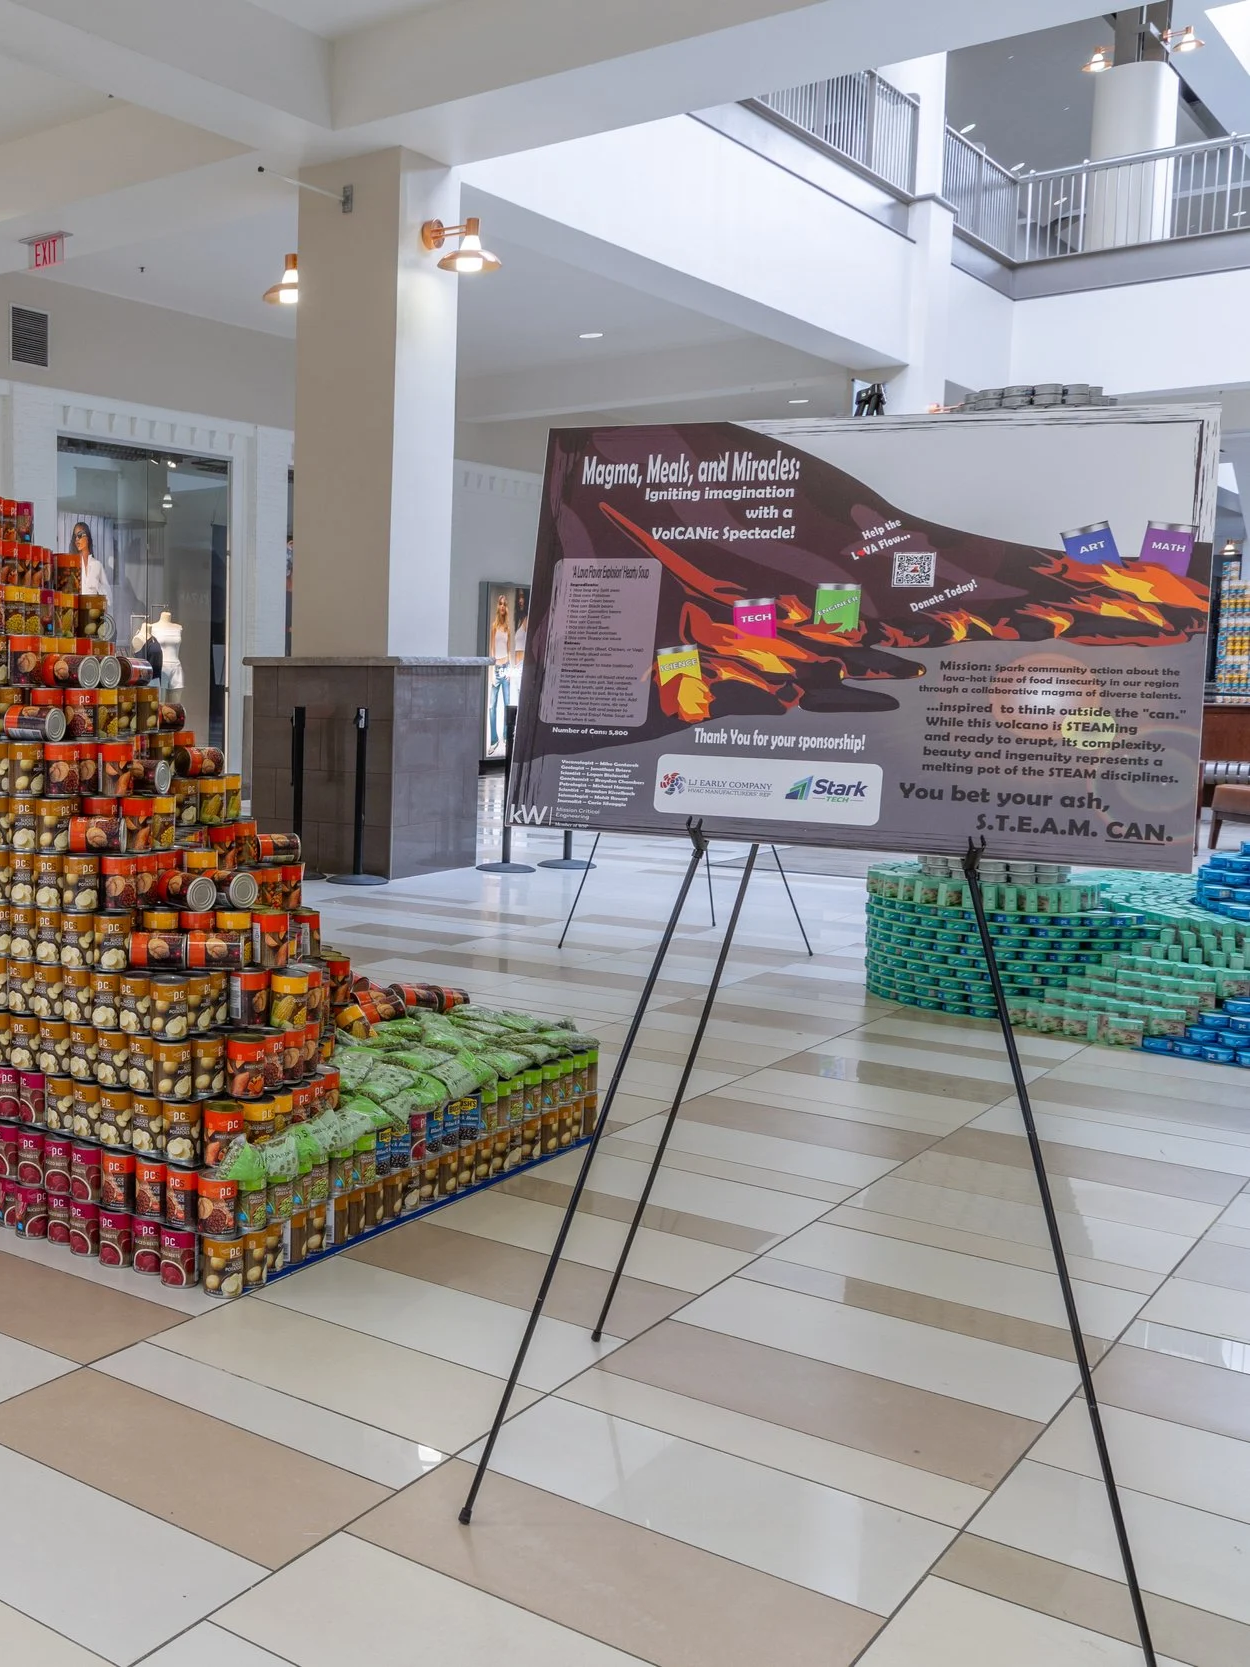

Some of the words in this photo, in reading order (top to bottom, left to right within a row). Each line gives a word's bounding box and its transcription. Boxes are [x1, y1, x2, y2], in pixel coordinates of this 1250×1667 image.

[34, 239, 57, 267] EXIT
[582, 456, 642, 489] Magma,
[646, 453, 693, 487] Meals,
[698, 452, 729, 483] and
[732, 450, 800, 482] Miracles:
[645, 488, 700, 502] Igniting
[704, 486, 794, 500] imagination
[746, 506, 778, 518] with
[782, 508, 792, 518] a
[652, 527, 718, 540] VolCANic
[722, 526, 796, 541] Spectacle!
[862, 527, 884, 540] Help
[886, 519, 902, 531] the
[878, 534, 911, 550] Flow...
[1080, 540, 1106, 554] ART
[1152, 542, 1186, 552] MATH
[638, 566, 650, 579] Soup
[910, 594, 944, 613] Donate
[944, 578, 978, 598] Today!
[816, 596, 860, 616] ENGINEER
[740, 613, 772, 623] TECH
[659, 658, 697, 672] SCIENCE
[940, 660, 991, 672] Mission:
[995, 664, 1024, 673] Spark
[1028, 666, 1087, 675] community
[1162, 668, 1180, 676] the
[943, 674, 987, 682] lava-hot
[1056, 678, 1106, 687] insecurity
[919, 685, 958, 694] through
[971, 686, 1038, 696] collaborative
[1099, 690, 1137, 698] diverse
[1140, 691, 1181, 699] talents.
[927, 702, 993, 713] ...inspired
[1001, 705, 1014, 714] to
[1018, 705, 1055, 715] think
[1060, 707, 1111, 717] outside
[1115, 708, 1138, 718] the
[1142, 709, 1186, 719] "can."
[926, 717, 964, 727] While
[968, 718, 991, 728] this
[995, 720, 1048, 730] volcano
[1052, 721, 1062, 731] is
[1066, 722, 1138, 735] STEAMing
[694, 728, 727, 744] Thank
[730, 730, 751, 745] You
[753, 730, 769, 746] for
[770, 734, 796, 750] your
[798, 734, 866, 753] sponsorship!
[924, 732, 950, 741] and
[954, 734, 993, 745] ready
[998, 735, 1011, 744] to
[1015, 738, 1057, 747] erupt,
[1062, 738, 1078, 747] its
[1082, 740, 1165, 752] complexity,
[923, 746, 971, 759] beauty
[974, 749, 1001, 759] and
[1005, 750, 1072, 764] ingenuity
[1076, 755, 1148, 766] represents
[922, 762, 973, 774] melting
[977, 766, 1000, 775] pot
[1004, 766, 1018, 775] of
[1022, 766, 1044, 776] the
[1049, 768, 1096, 779] STEAM
[1101, 770, 1179, 783] disciplines.
[700, 779, 729, 788] EARLY
[729, 781, 772, 790] COMPANY
[812, 778, 868, 798] Stark
[900, 783, 944, 801] You
[951, 785, 990, 802] bet
[997, 791, 1052, 808] your
[1060, 792, 1110, 813] ash,
[976, 813, 1098, 837] S.T.E.A.M.
[1105, 821, 1173, 842] CAN.
